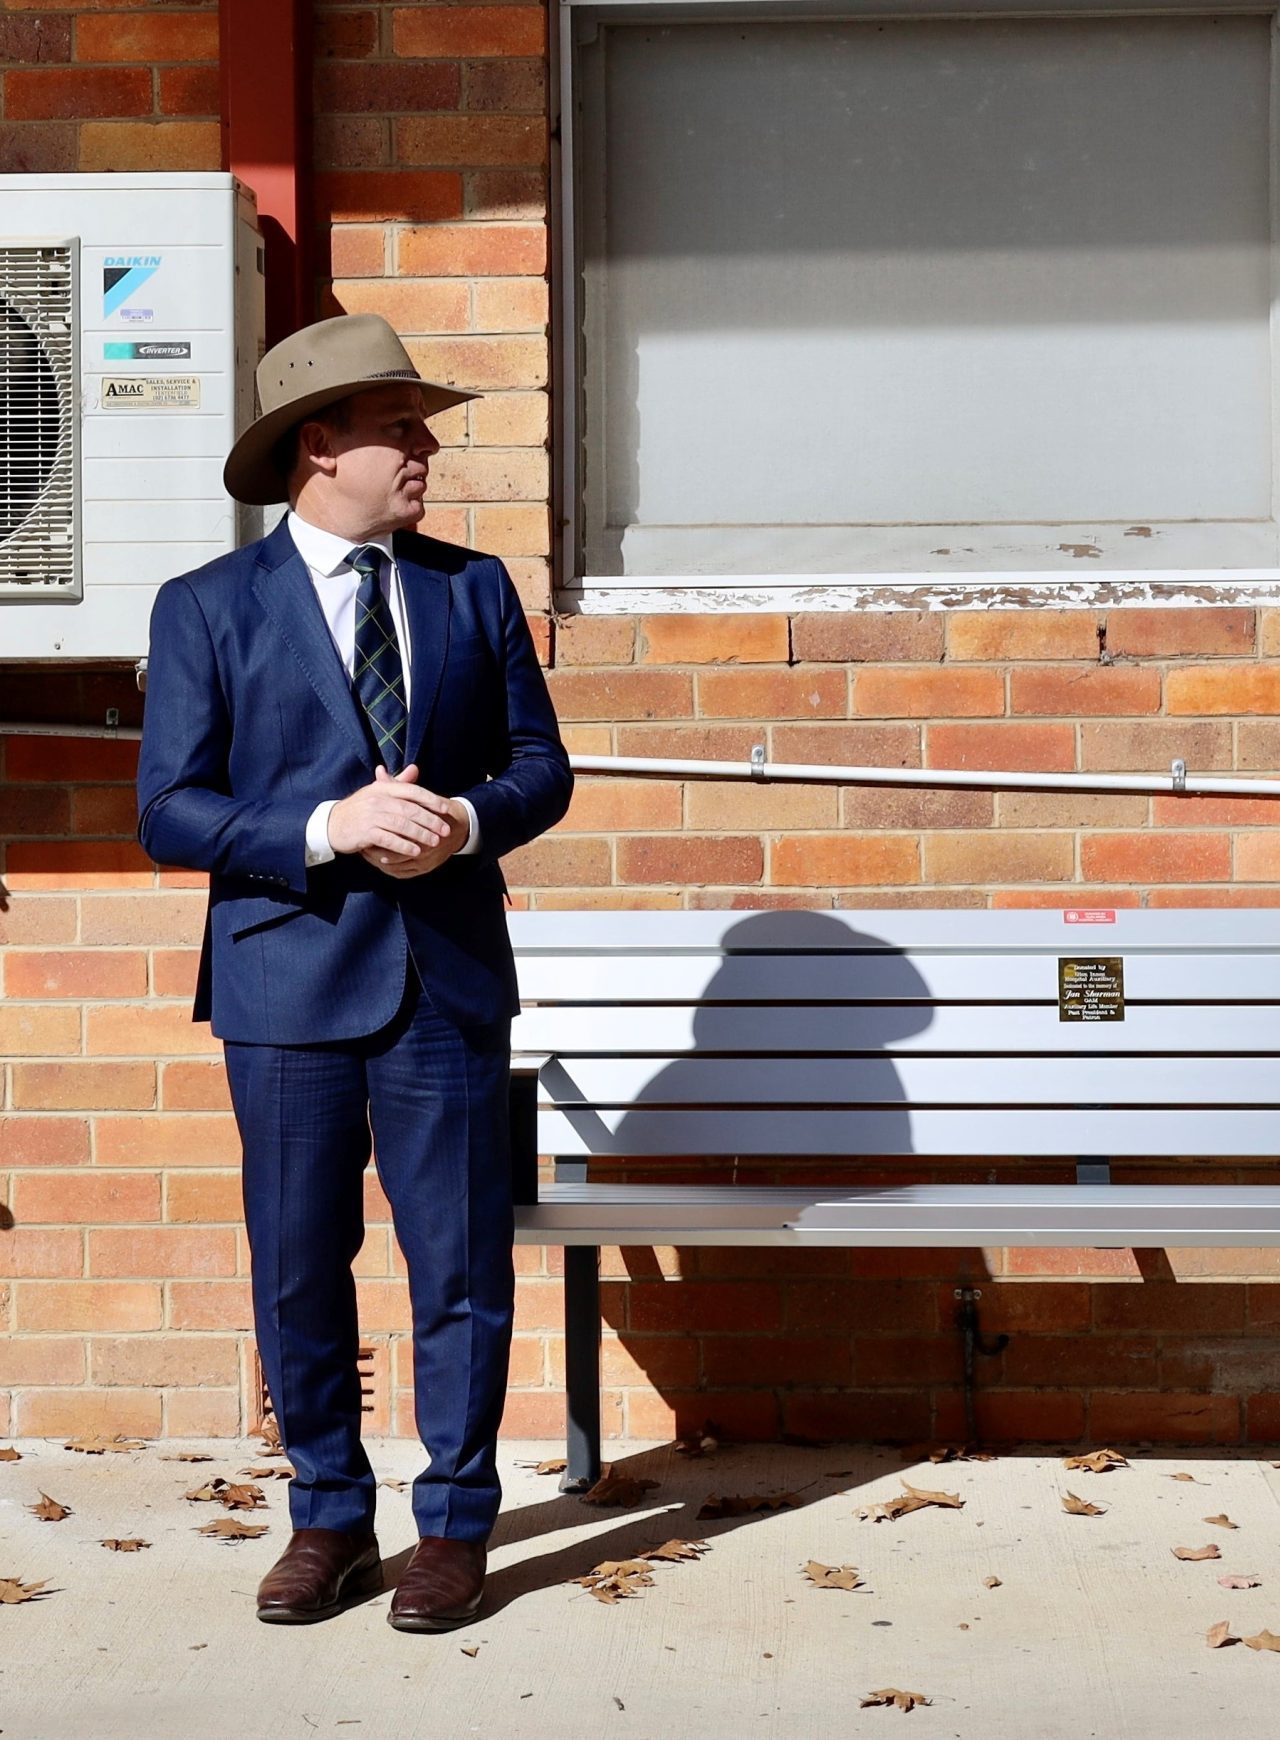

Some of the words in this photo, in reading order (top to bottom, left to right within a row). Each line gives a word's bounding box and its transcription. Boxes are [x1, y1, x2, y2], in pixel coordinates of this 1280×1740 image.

[103, 256, 162, 266] DAIKIN
[105, 383, 144, 397] AMAC
[1063, 990, 1080, 1000] Jan
[1083, 990, 1121, 998] Sharman
